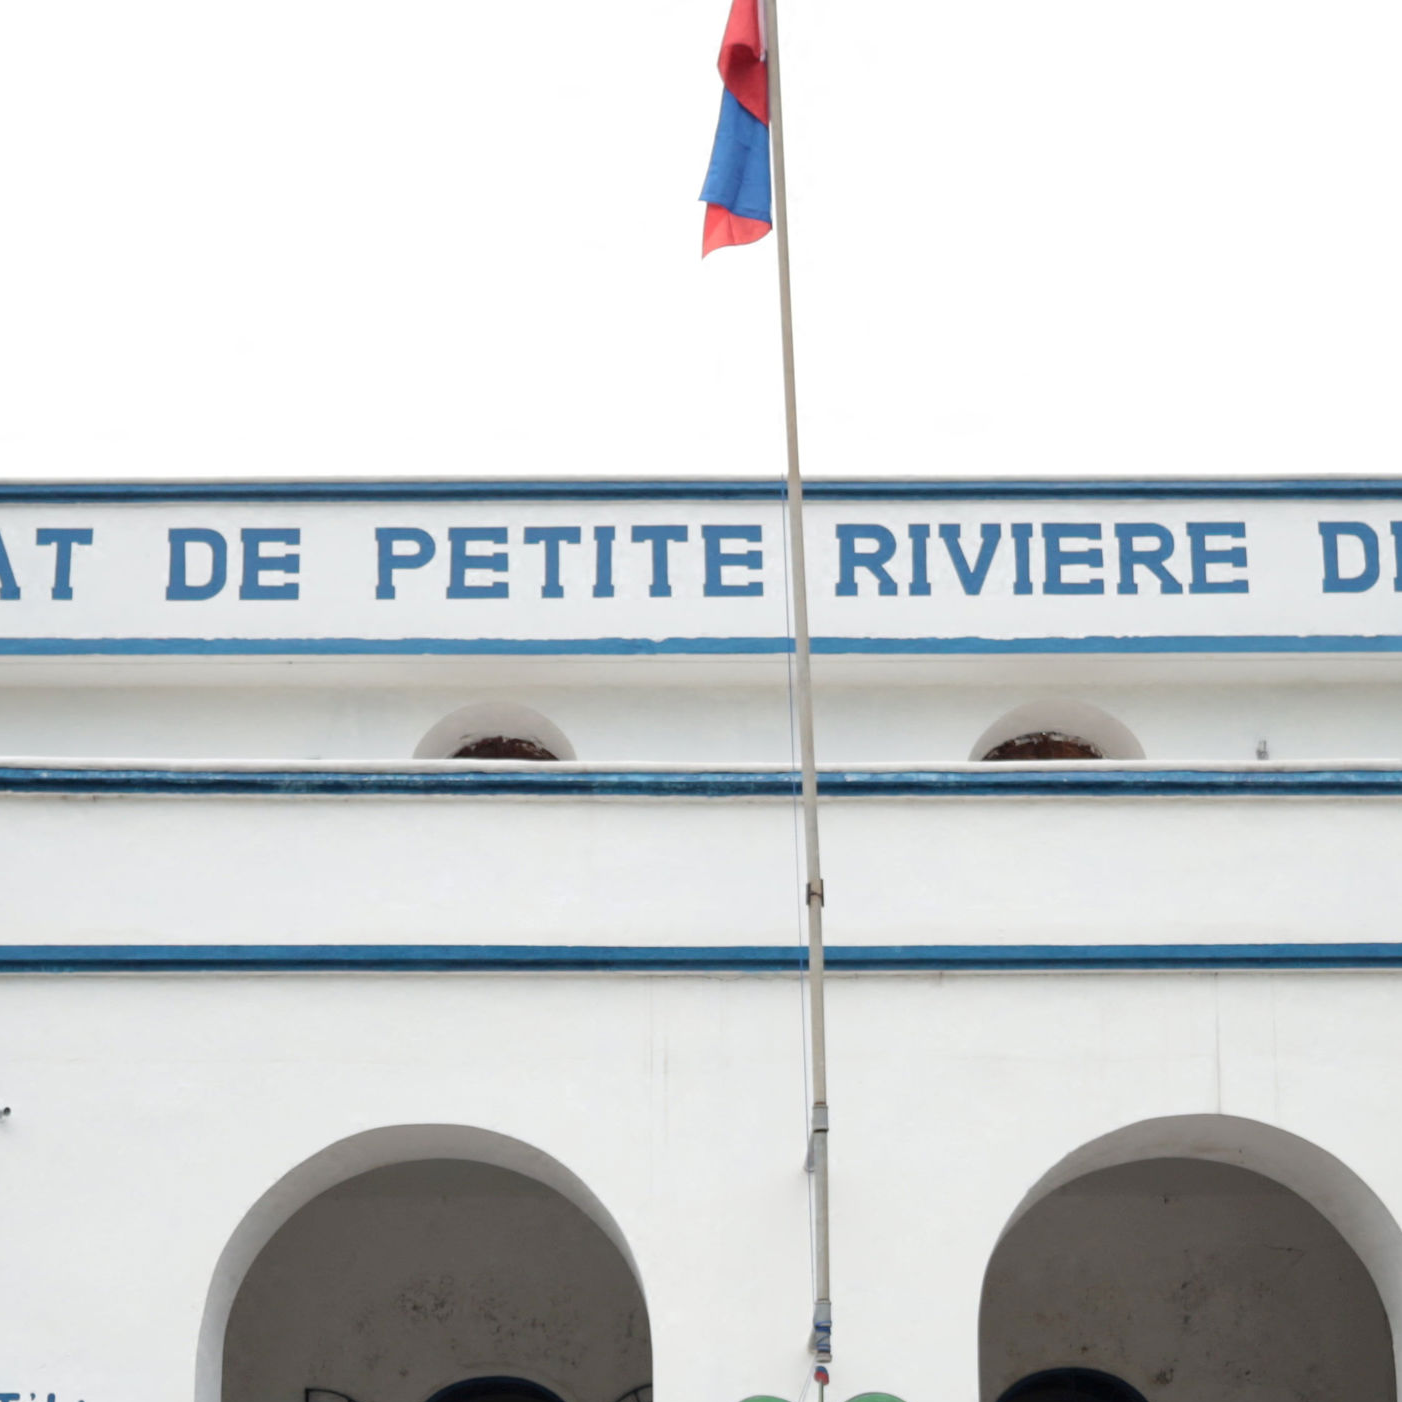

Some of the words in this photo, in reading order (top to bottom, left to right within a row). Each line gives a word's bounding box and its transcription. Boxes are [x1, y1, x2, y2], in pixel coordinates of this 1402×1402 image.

[167, 528, 300, 602] DE
[375, 525, 764, 600] PETITE
[835, 522, 1250, 597] RIVIERE
